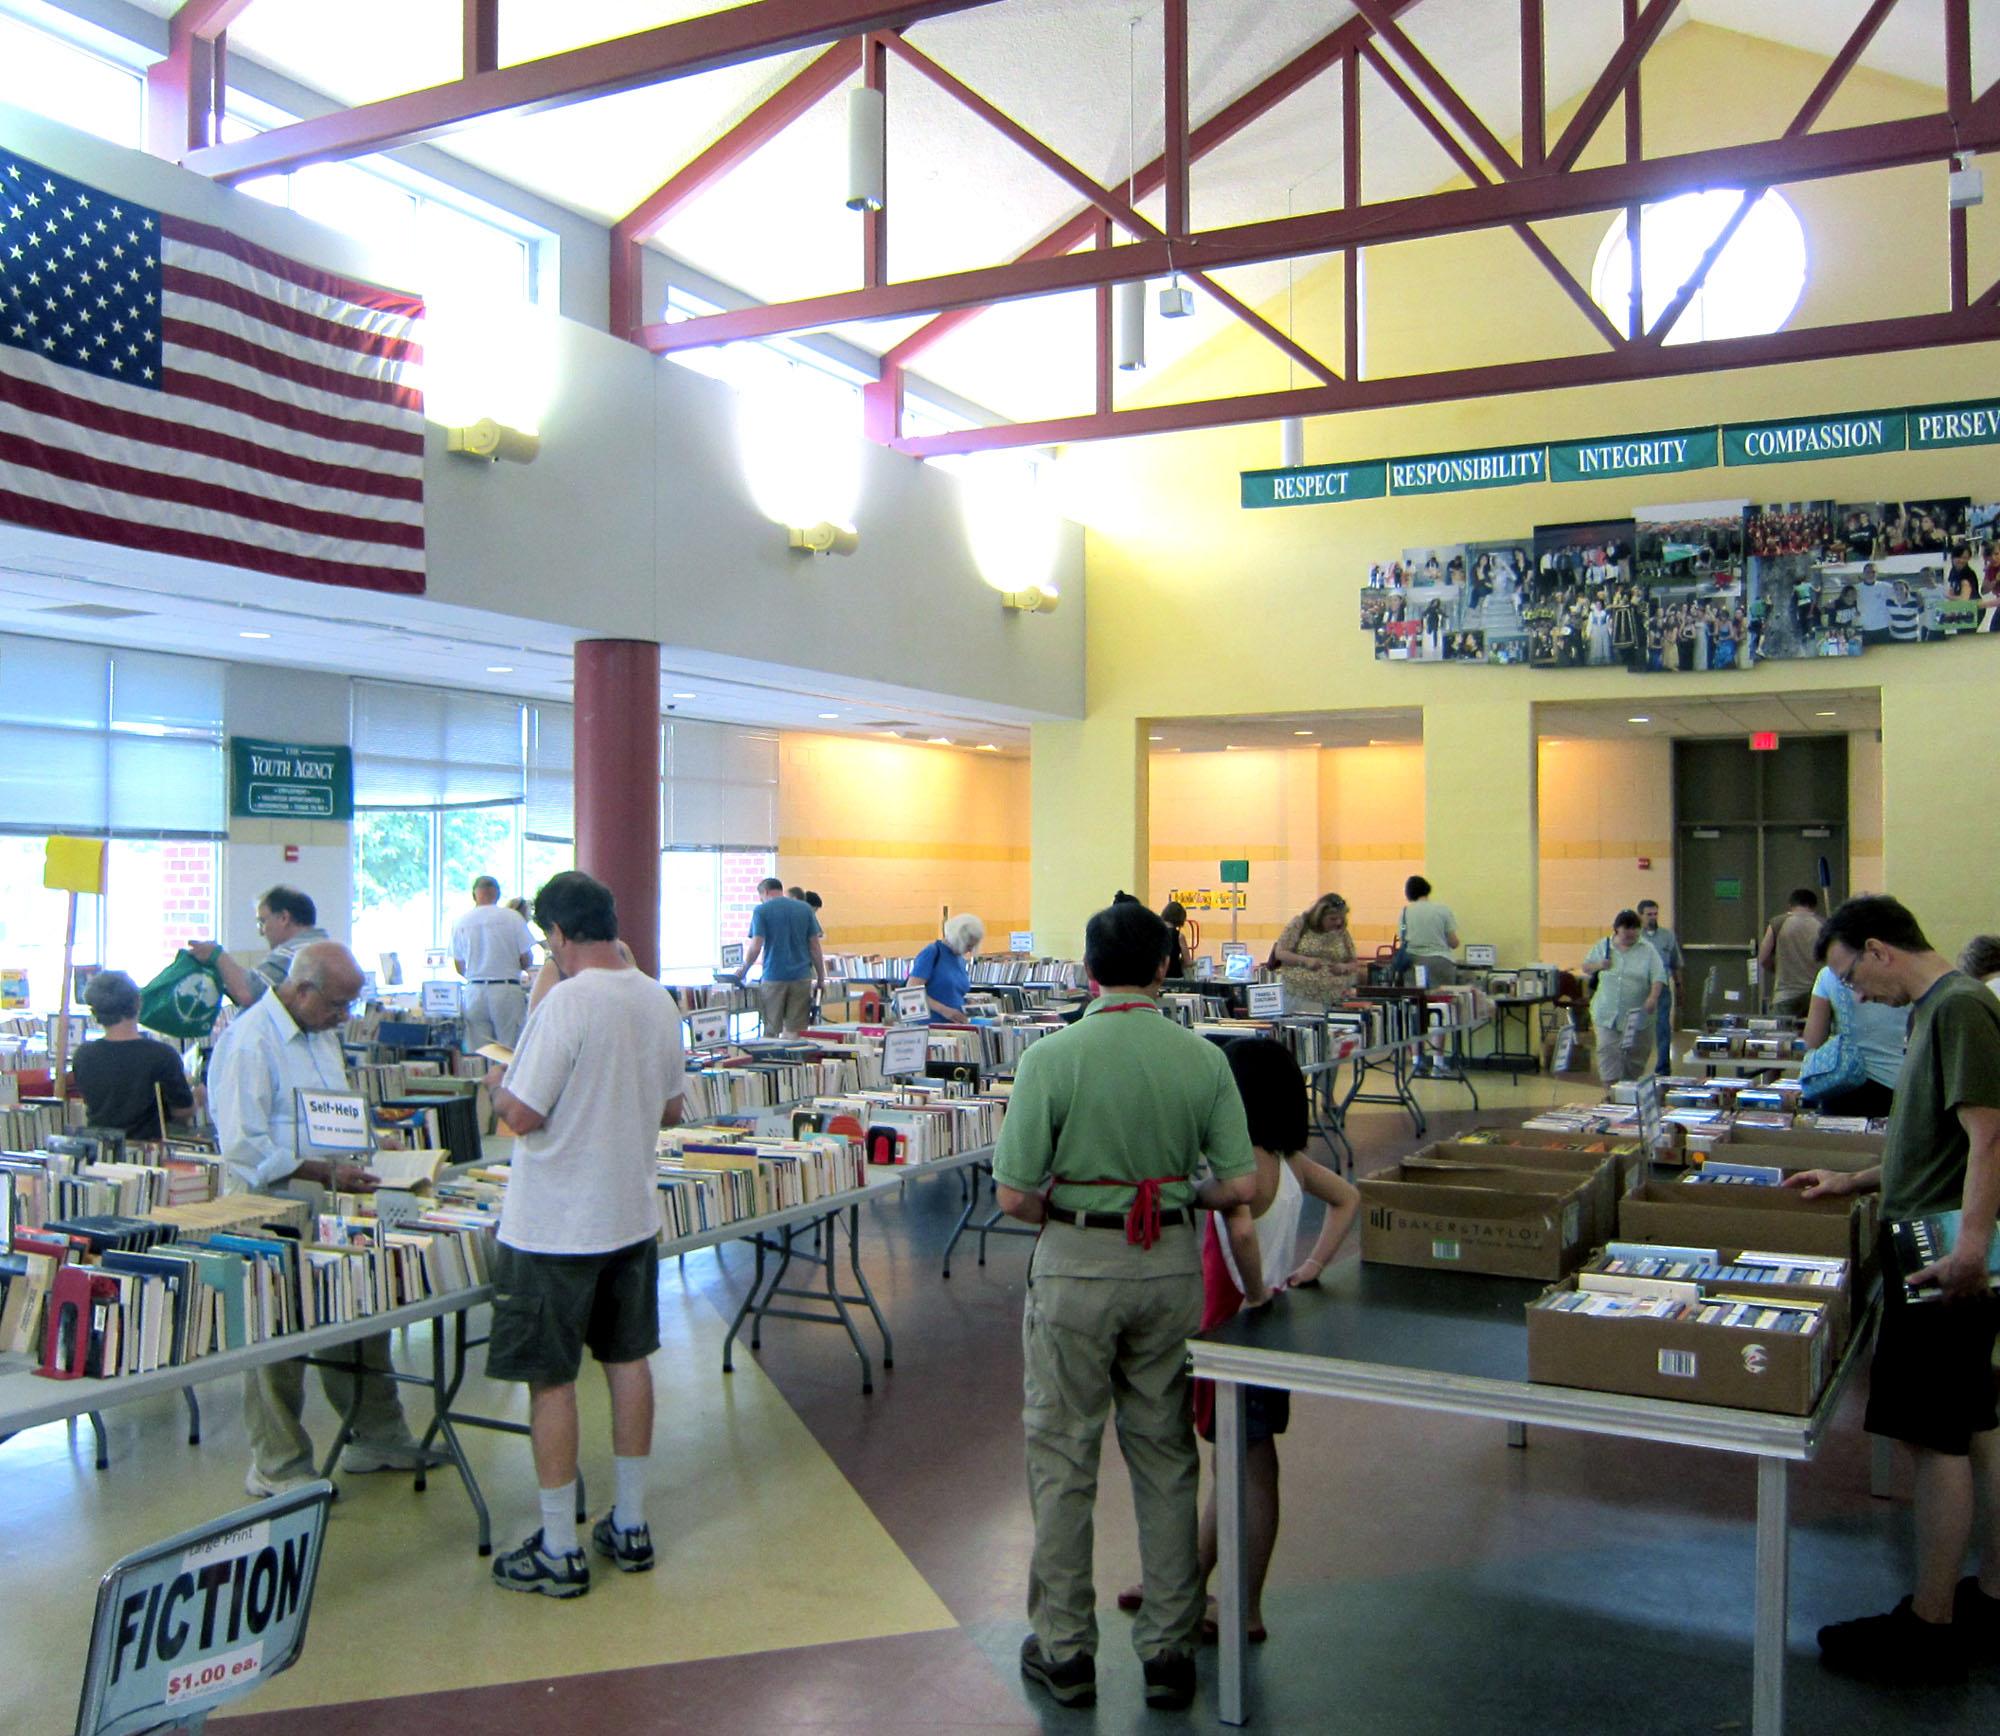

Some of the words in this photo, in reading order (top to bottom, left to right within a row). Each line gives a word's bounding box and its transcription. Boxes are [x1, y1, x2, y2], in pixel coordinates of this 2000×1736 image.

[1744, 420, 1883, 457] COMPASSION
[1919, 410, 2000, 441] PERSEV
[1392, 450, 1543, 488] RESPONSIBILITY
[1578, 439, 1688, 473] INTEGRITY
[1273, 471, 1349, 500] RESPECT
[251, 755, 291, 777] YOUTH
[293, 759, 335, 780] AGENCY
[310, 1101, 359, 1119] Self-Help
[223, 1527, 254, 1545] Print
[111, 1532, 309, 1687] FICTION
[168, 1663, 226, 1695] $1.00
[231, 1657, 258, 1676] ea.
